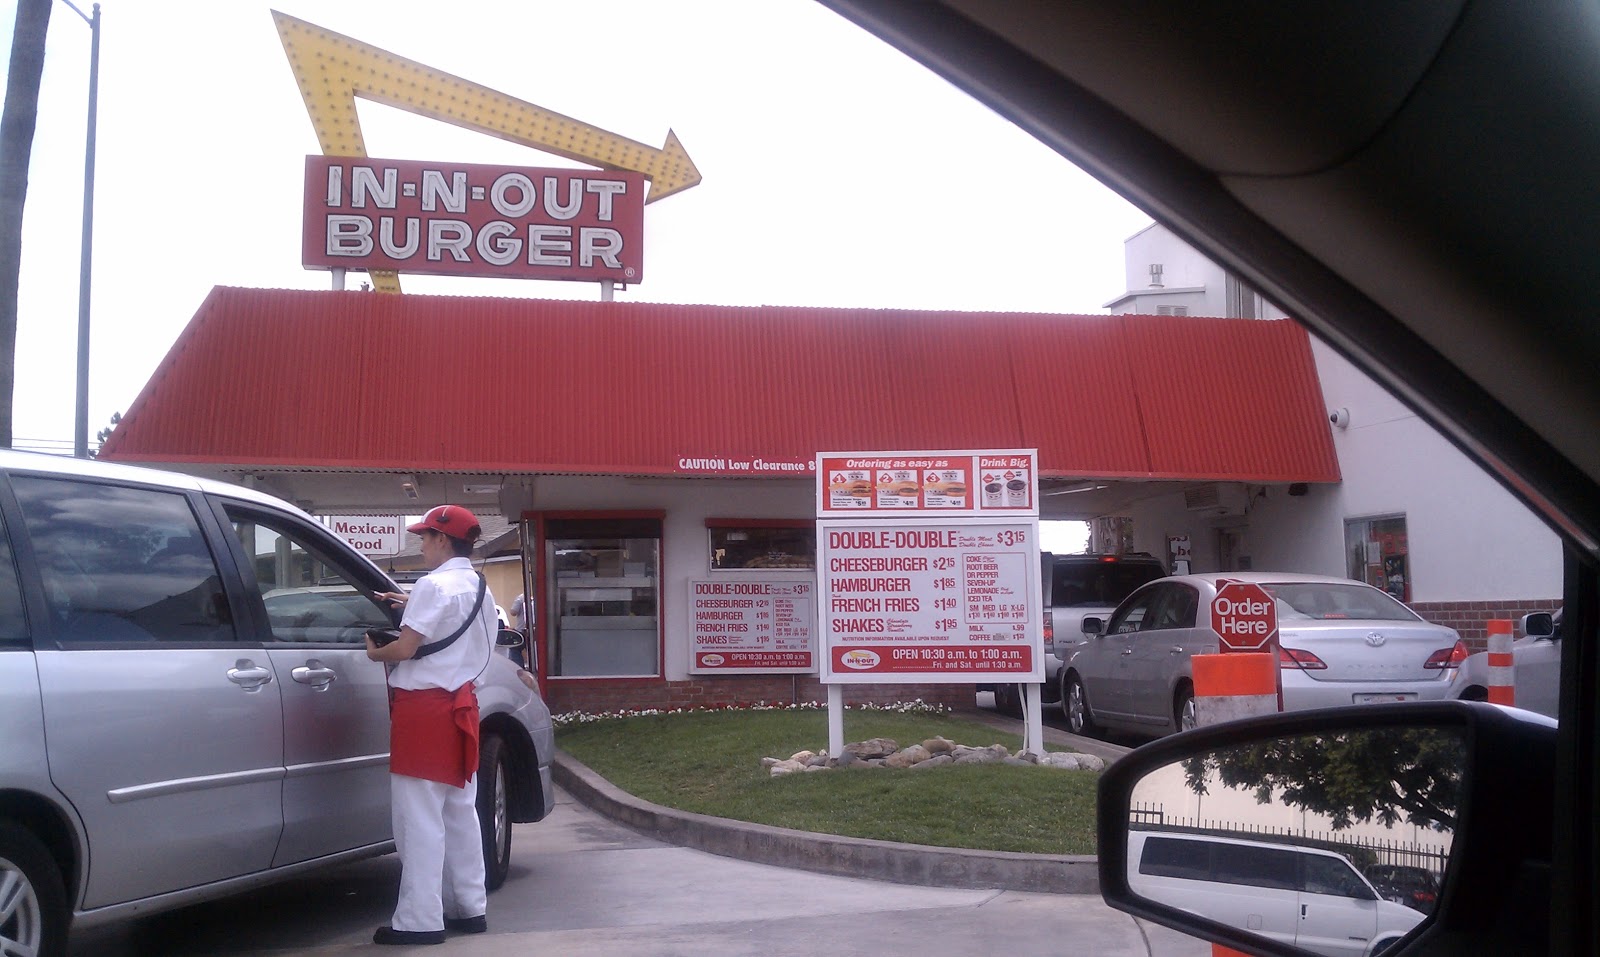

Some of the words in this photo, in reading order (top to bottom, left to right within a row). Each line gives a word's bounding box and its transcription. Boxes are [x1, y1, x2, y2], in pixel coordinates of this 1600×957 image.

[326, 165, 626, 221] IN-N-OUT
[326, 214, 624, 269] BURGER
[679, 458, 725, 470] CAUTION
[728, 459, 750, 470] Low
[753, 459, 805, 471] Clearance
[846, 459, 892, 469] Ordering
[908, 460, 934, 469] easy
[981, 458, 1007, 467] Drink
[836, 475, 843, 483] 1
[882, 474, 890, 482] 2
[334, 522, 395, 534] Mexican
[829, 530, 957, 549] DOUBLE-DOUBLE
[830, 557, 928, 572] CHEESEBURGER
[696, 584, 770, 595] DOUBLE-DOUBLE
[831, 578, 911, 592] HAMBURGER
[696, 599, 753, 608] CHEESEBURGER
[832, 598, 880, 612] FRENCH
[885, 598, 920, 612] FRIES
[1215, 598, 1271, 615] Order
[696, 611, 743, 620] HAMBURGER
[696, 624, 725, 632] FRENCH
[728, 624, 748, 632] FRIES
[832, 619, 884, 633] SHAKES
[1221, 617, 1268, 634] Here
[696, 636, 727, 644] SHAKES
[893, 649, 918, 659] OPEN
[920, 649, 945, 659] 10:30
[947, 650, 968, 659] a.m.
[969, 649, 978, 659] to
[980, 649, 999, 659] 1:00
[1002, 650, 1022, 659] a.m.
[945, 661, 958, 669] and
